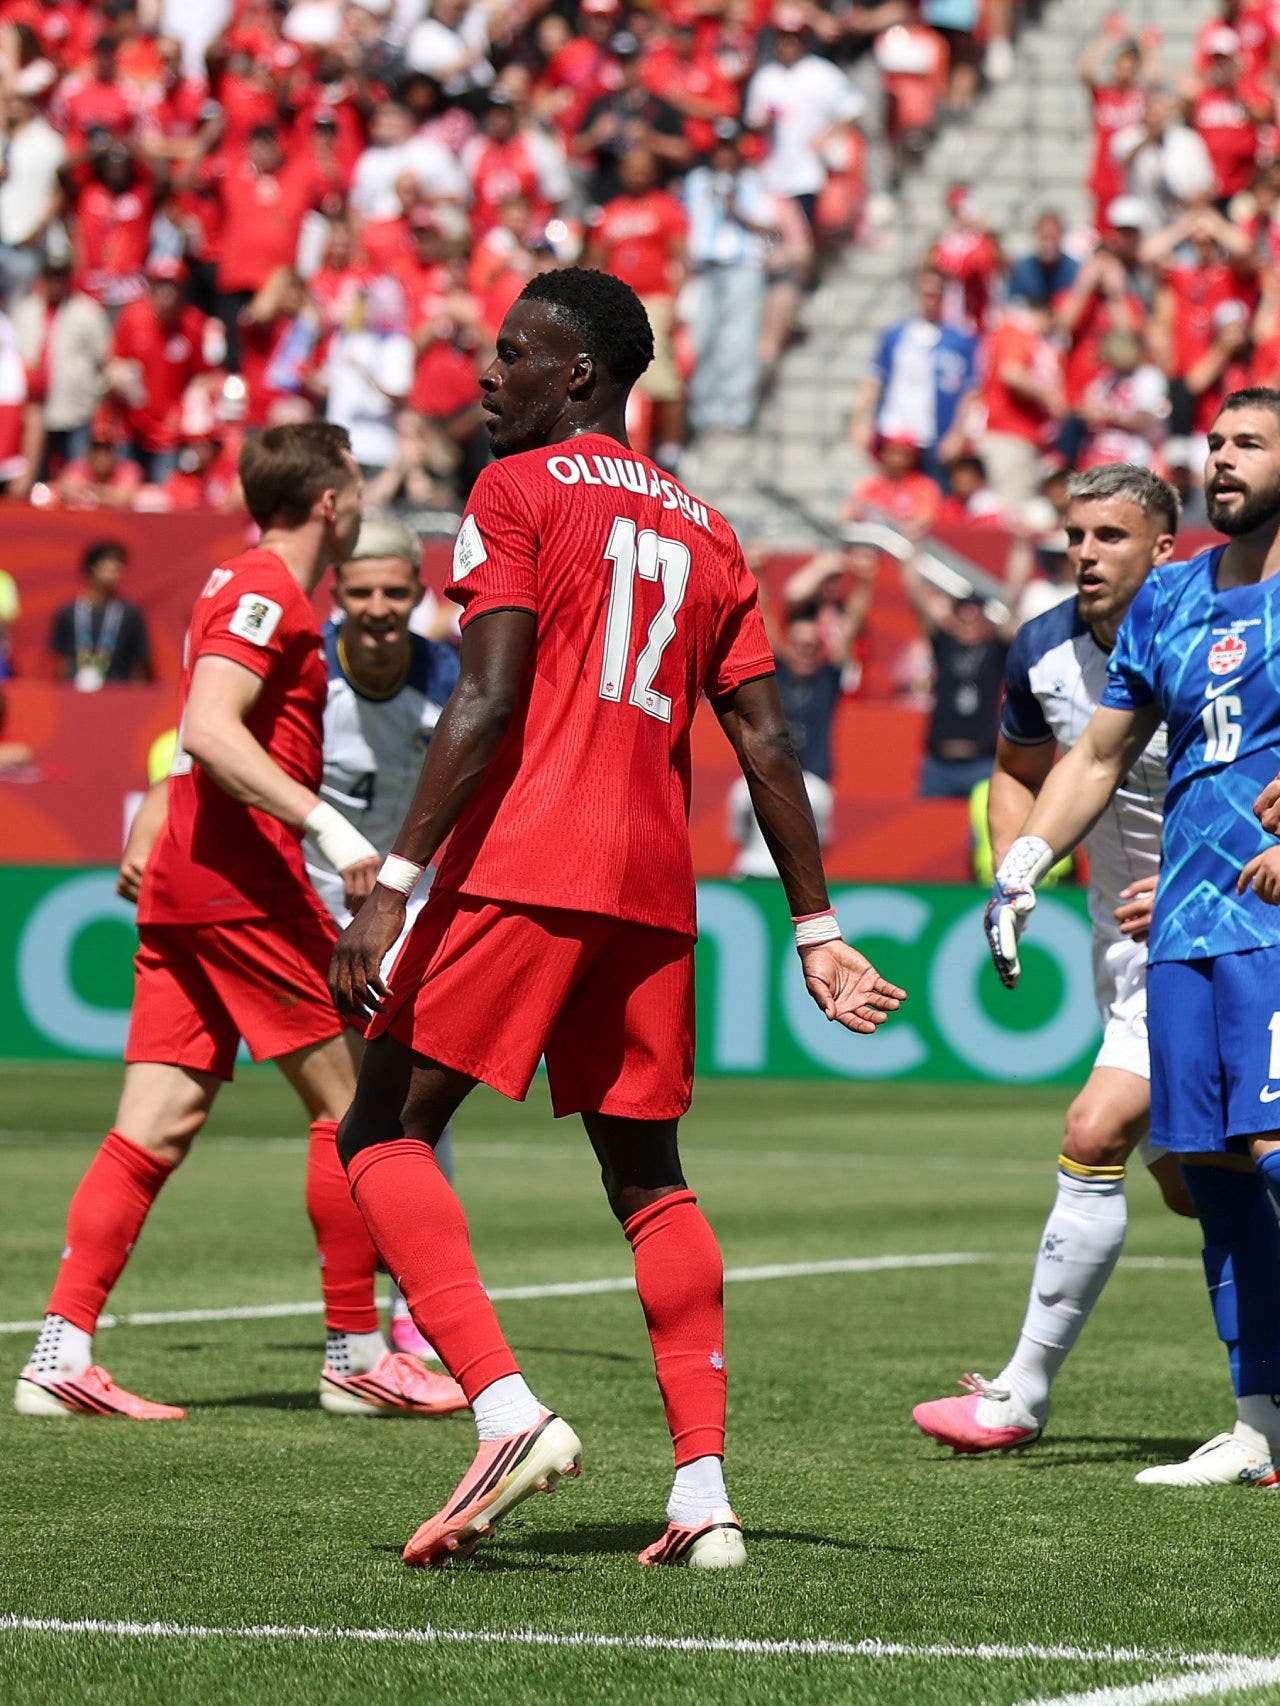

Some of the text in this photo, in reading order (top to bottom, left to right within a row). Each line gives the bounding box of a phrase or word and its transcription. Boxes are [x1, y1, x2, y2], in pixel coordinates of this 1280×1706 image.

[599, 516, 691, 723] 12
[1201, 695, 1242, 762] 16
[348, 772, 376, 812] 4
